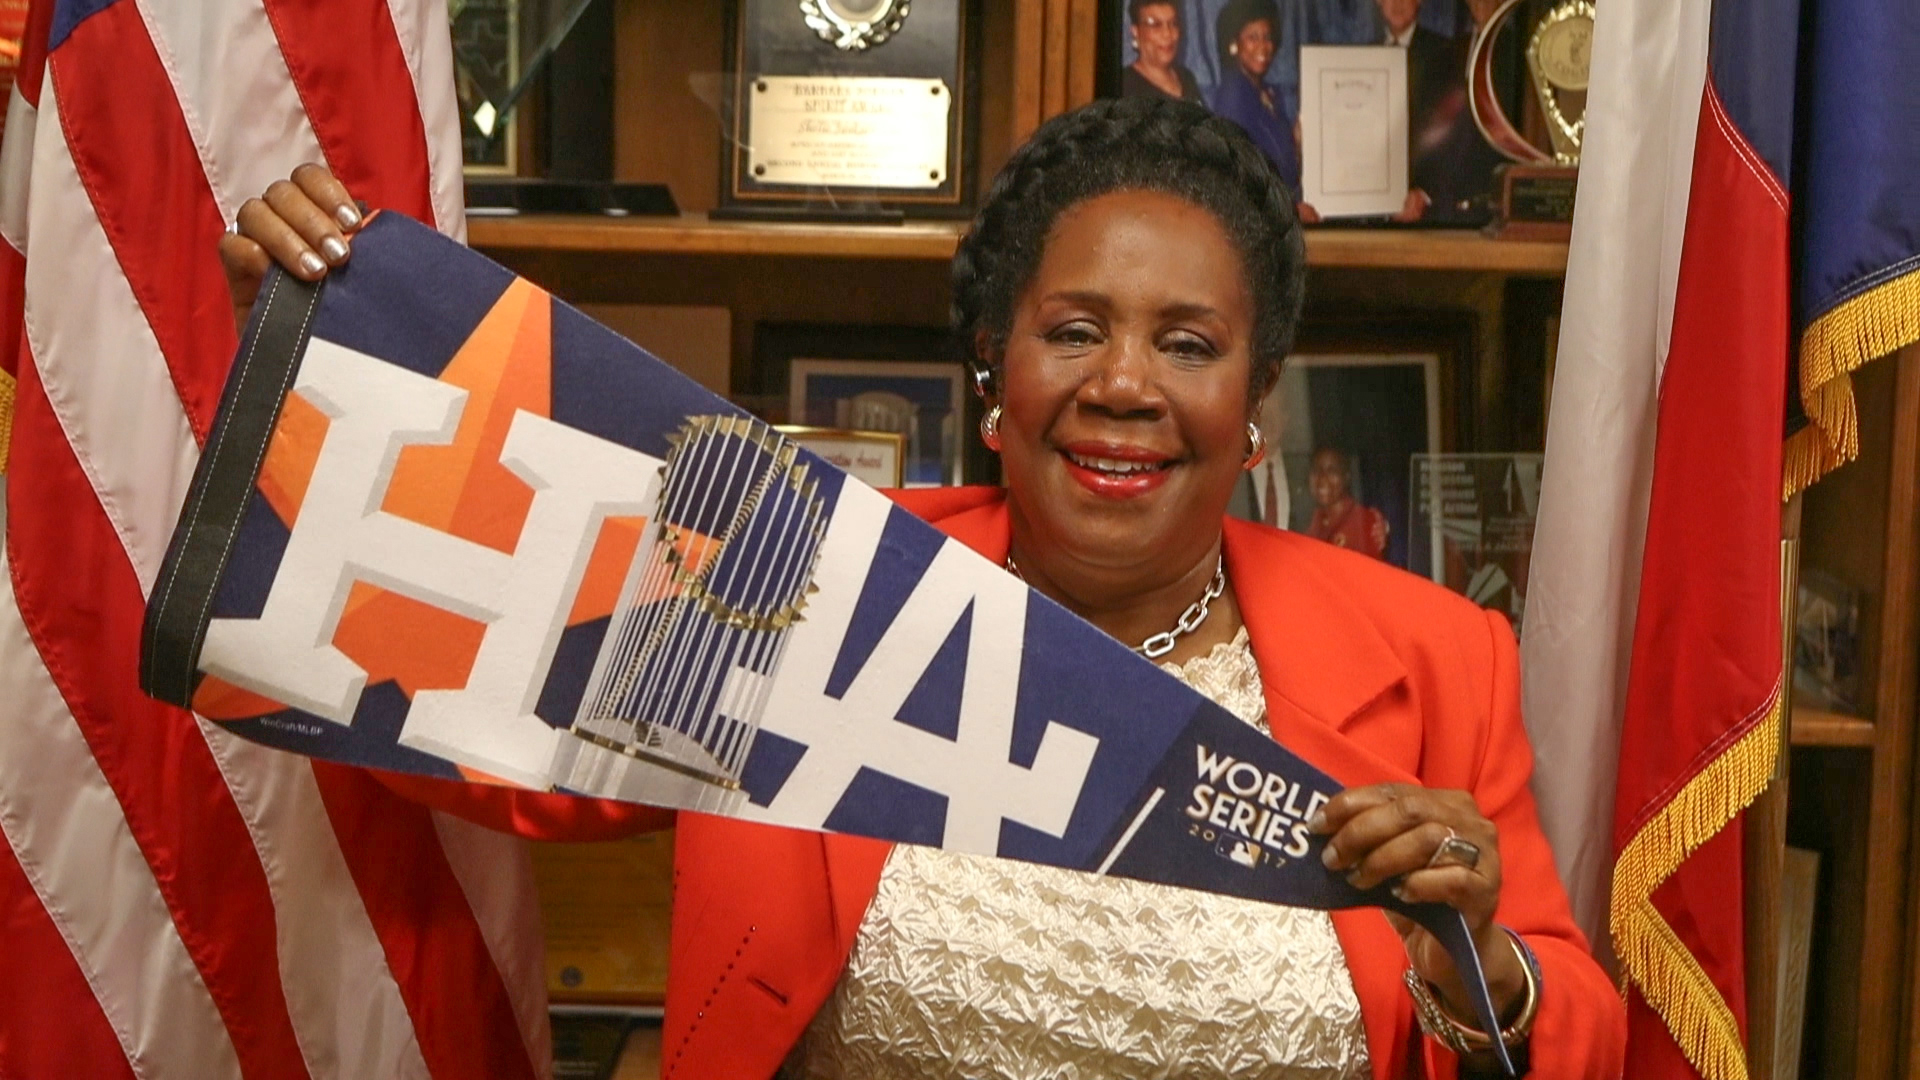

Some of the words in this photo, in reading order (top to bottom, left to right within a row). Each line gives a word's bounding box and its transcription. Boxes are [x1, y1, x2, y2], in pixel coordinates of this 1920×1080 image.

[197, 335, 669, 791] H
[1186, 784, 1310, 859] SERIES
[1188, 824, 1216, 842] 20
[1263, 852, 1287, 869] 17
